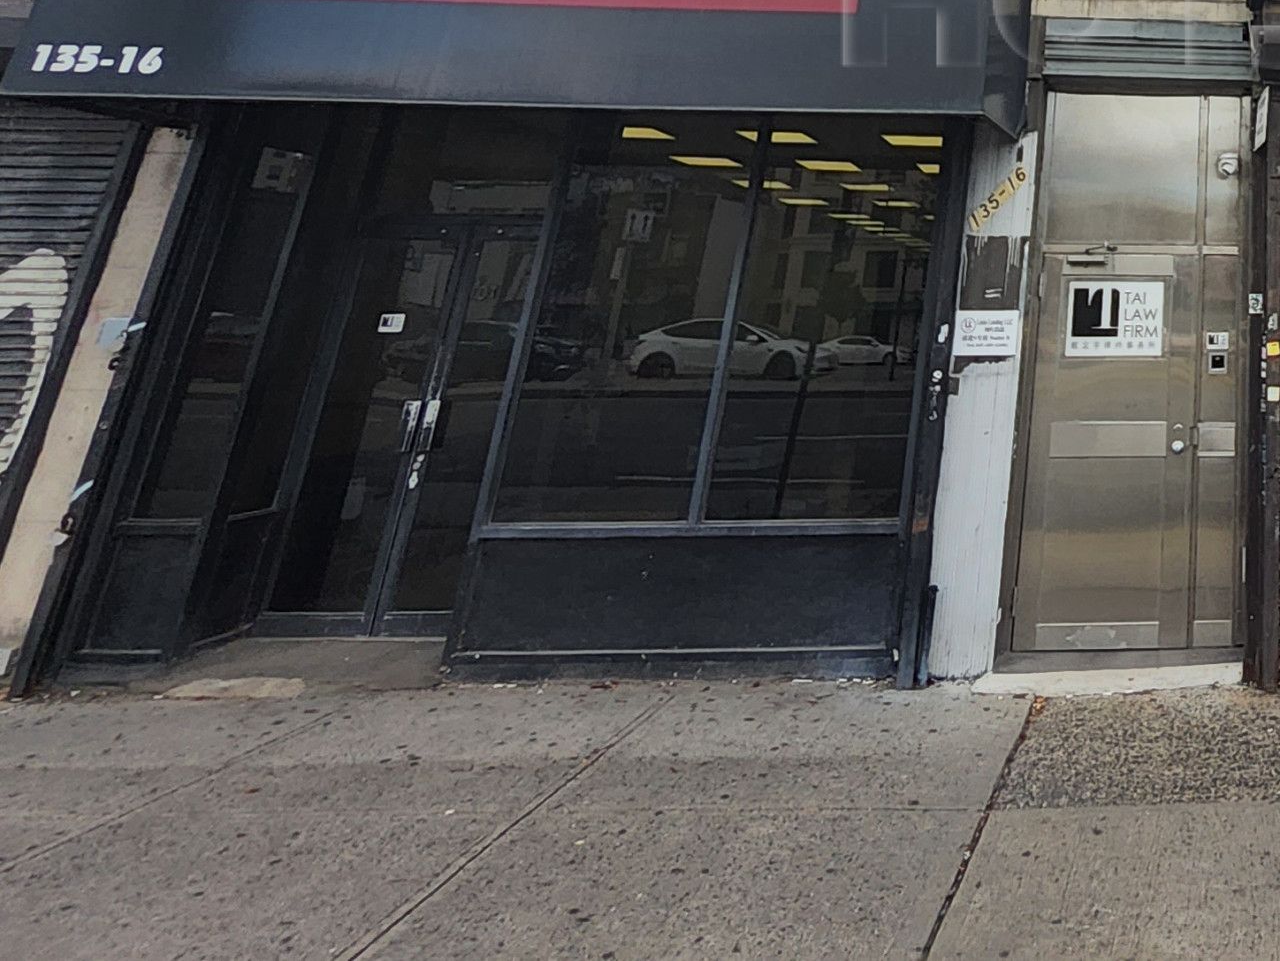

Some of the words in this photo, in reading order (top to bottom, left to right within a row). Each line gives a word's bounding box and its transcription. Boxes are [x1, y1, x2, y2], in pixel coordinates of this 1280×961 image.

[30, 44, 164, 75] 135-16
[971, 167, 1026, 228] 135-16
[1124, 291, 1147, 305] TAI
[1124, 308, 1159, 321] LAW
[1123, 324, 1159, 338] FIRM
